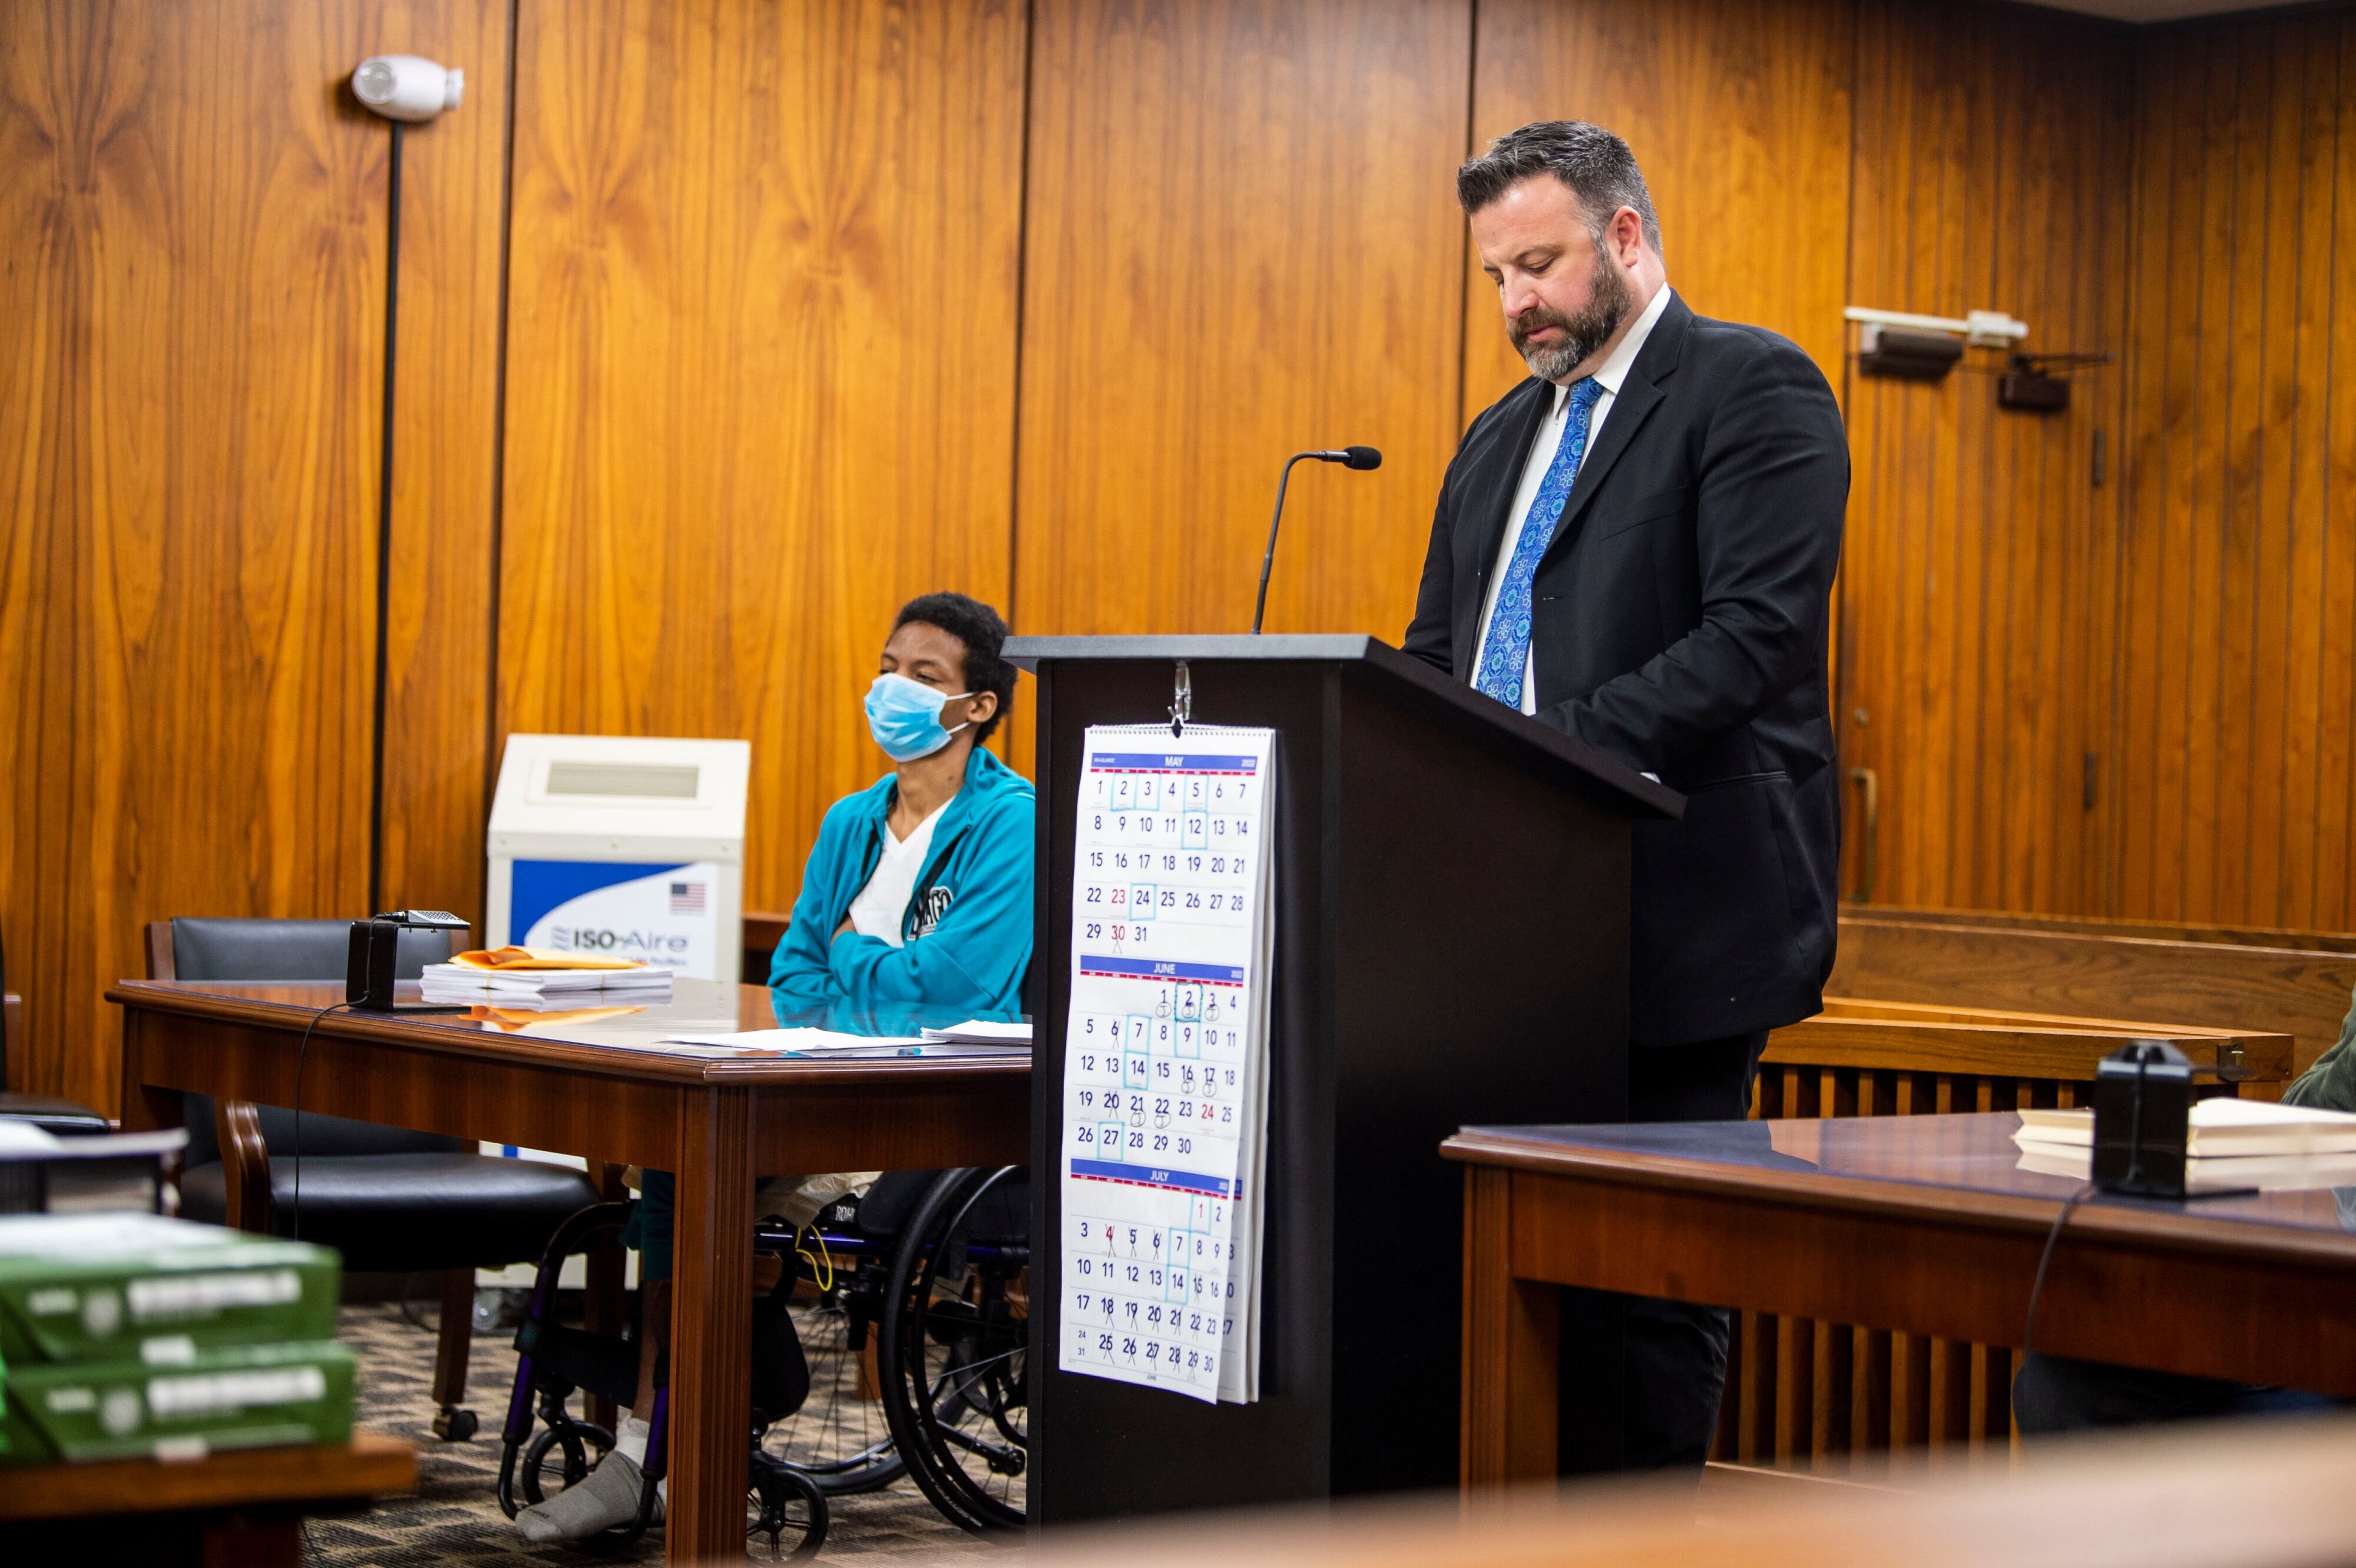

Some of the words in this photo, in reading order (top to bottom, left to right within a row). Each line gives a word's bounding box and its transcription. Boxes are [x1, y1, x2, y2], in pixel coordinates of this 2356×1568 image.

[1165, 756, 1183, 767] MAY
[1097, 780, 1103, 794] 1
[1120, 781, 1127, 795] 2
[1144, 782, 1151, 796] 3
[1169, 782, 1176, 796] 4
[1193, 783, 1199, 797] 5
[1215, 783, 1223, 798] 6
[1239, 784, 1246, 798] 7
[1094, 815, 1101, 829] 8
[1119, 816, 1126, 831] 9
[1139, 818, 1152, 832] 10
[1165, 818, 1176, 833] 11
[1189, 819, 1201, 834] 12
[1213, 821, 1225, 835] 13
[1236, 821, 1248, 835] 14
[1090, 852, 1103, 866] 15
[1115, 854, 1127, 868] 16
[1139, 855, 1150, 869] 17
[1163, 856, 1176, 870] 18
[1187, 857, 1201, 871] 19
[1212, 858, 1225, 872] 20
[1233, 859, 1245, 874] 21
[1087, 888, 1101, 902] 22
[1111, 889, 1126, 904] 23
[1136, 891, 1150, 905] 24
[1161, 892, 1175, 906] 25
[1186, 894, 1200, 908] 26
[1210, 895, 1223, 909] 27
[1231, 896, 1243, 911] 28
[574, 928, 688, 952] ISO-Aire
[1087, 924, 1101, 938] 29
[1111, 925, 1125, 940] 30
[1134, 927, 1147, 941] 31
[1153, 963, 1176, 974] JUNE
[1161, 990, 1166, 1003] 1
[1186, 991, 1192, 1006] 2
[1209, 993, 1216, 1007] 3
[1230, 995, 1236, 1009] 4
[1086, 1019, 1093, 1033] 5
[1111, 1021, 1119, 1035] 6
[1136, 1024, 1142, 1037] 7
[1160, 1026, 1167, 1040] 8
[1184, 1028, 1191, 1041] 9
[1205, 1030, 1217, 1044] 10
[1227, 1032, 1236, 1047] 11
[1081, 1056, 1094, 1070] 12
[1106, 1058, 1119, 1073] 13
[1131, 1060, 1144, 1075] 14
[1156, 1063, 1169, 1077] 15
[1181, 1065, 1193, 1080] 16
[1205, 1068, 1215, 1082] 17
[1225, 1070, 1235, 1085] 18
[1079, 1091, 1093, 1106] 19
[1104, 1094, 1119, 1109] 20
[1130, 1096, 1143, 1110] 21
[1155, 1099, 1169, 1113] 22
[1179, 1101, 1192, 1116] 23
[1202, 1104, 1213, 1119] 24
[1222, 1107, 1232, 1122] 25
[1078, 1127, 1093, 1142] 26
[1103, 1130, 1119, 1144] 27
[1129, 1133, 1143, 1147] 28
[1154, 1136, 1168, 1150] 29
[1177, 1139, 1191, 1153] 30
[1150, 1170, 1169, 1182] JULY
[1199, 1203, 1203, 1218] 1
[1216, 1206, 1222, 1222] 2
[1081, 1223, 1088, 1237] 3
[1106, 1226, 1113, 1240] 4
[1130, 1230, 1136, 1244] 5
[1153, 1233, 1160, 1248] 6
[1176, 1237, 1182, 1251] 7
[1197, 1240, 1202, 1255] 8
[1215, 1244, 1220, 1259] 9
[1077, 1259, 1091, 1274] 10
[1102, 1263, 1114, 1278] 11
[1126, 1266, 1139, 1282] 12
[1150, 1271, 1162, 1285] 13
[1172, 1274, 1183, 1289] 14
[1193, 1278, 1202, 1294] 15
[1211, 1282, 1219, 1297] 16
[1077, 1295, 1090, 1310] 17
[1101, 1298, 1114, 1314] 18
[1125, 1302, 1138, 1317] 19
[1147, 1306, 1161, 1322] 20
[1170, 1310, 1181, 1326] 21
[1190, 1315, 1200, 1330] 22
[1207, 1319, 1216, 1335] 23
[1078, 1331, 1086, 1339] 24
[1099, 1335, 1113, 1350] 25
[1123, 1339, 1136, 1354] 26
[1146, 1342, 1159, 1358] 27
[1169, 1347, 1180, 1363] 28
[1188, 1351, 1198, 1367] 29
[1204, 1356, 1213, 1372] 30
[1078, 1348, 1085, 1356] 31
